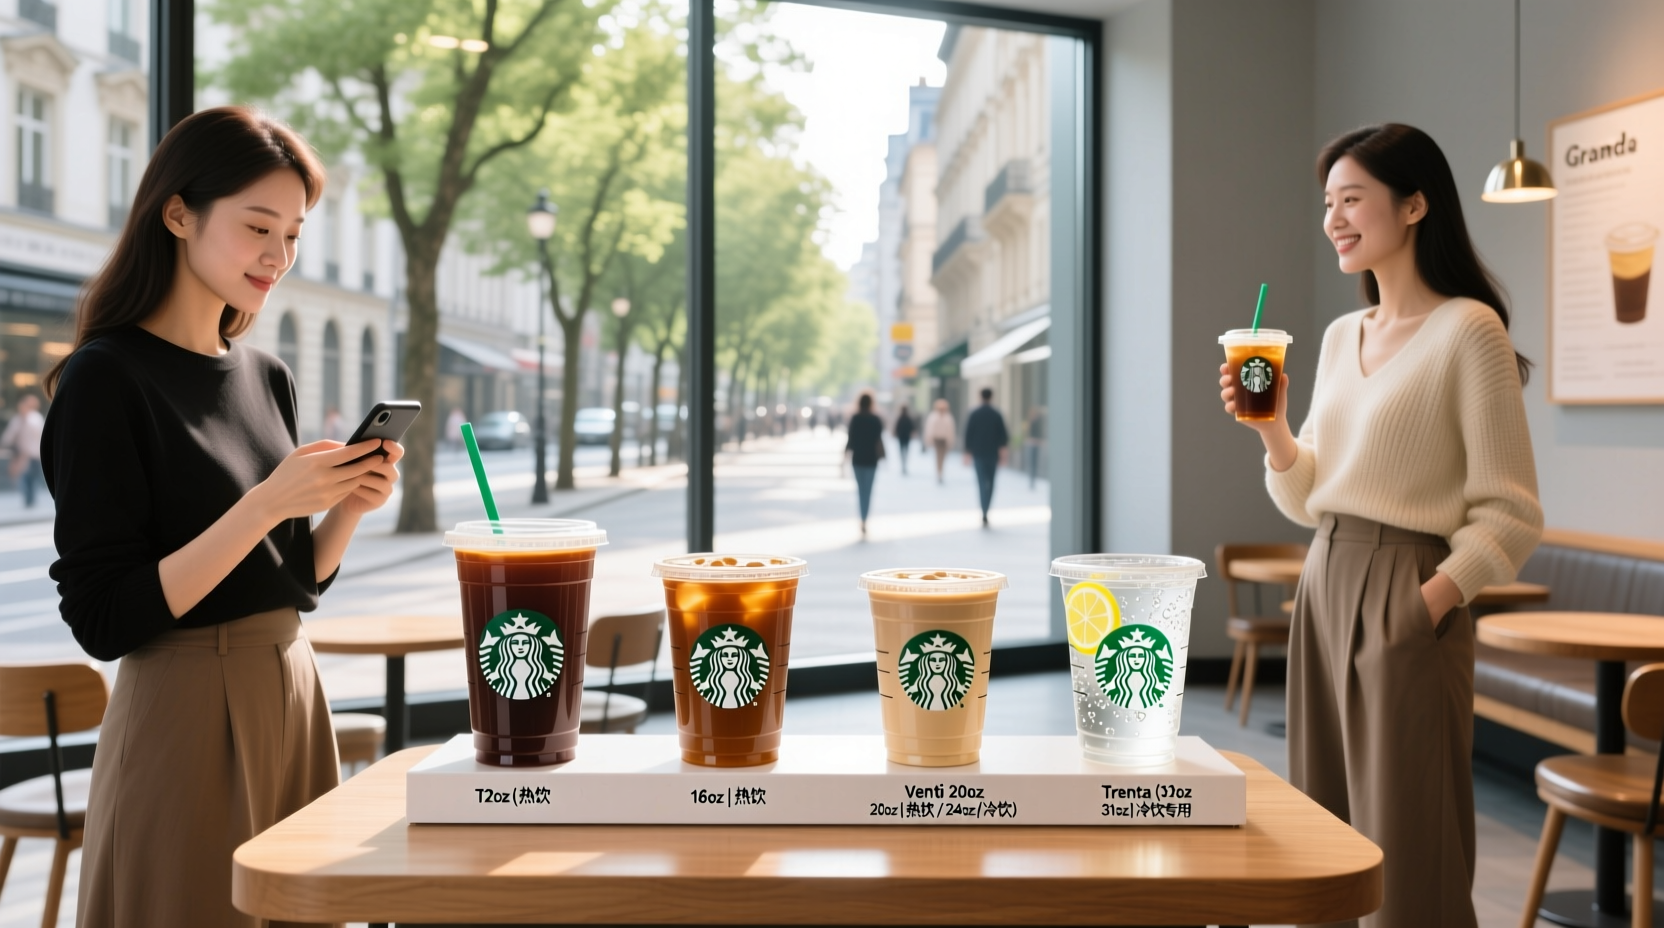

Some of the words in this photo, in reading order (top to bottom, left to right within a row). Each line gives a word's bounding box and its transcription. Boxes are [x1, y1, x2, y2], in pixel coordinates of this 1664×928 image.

[904, 783, 945, 799] Venti
[948, 784, 985, 799] 20oz
[1101, 784, 1152, 799] Trenta
